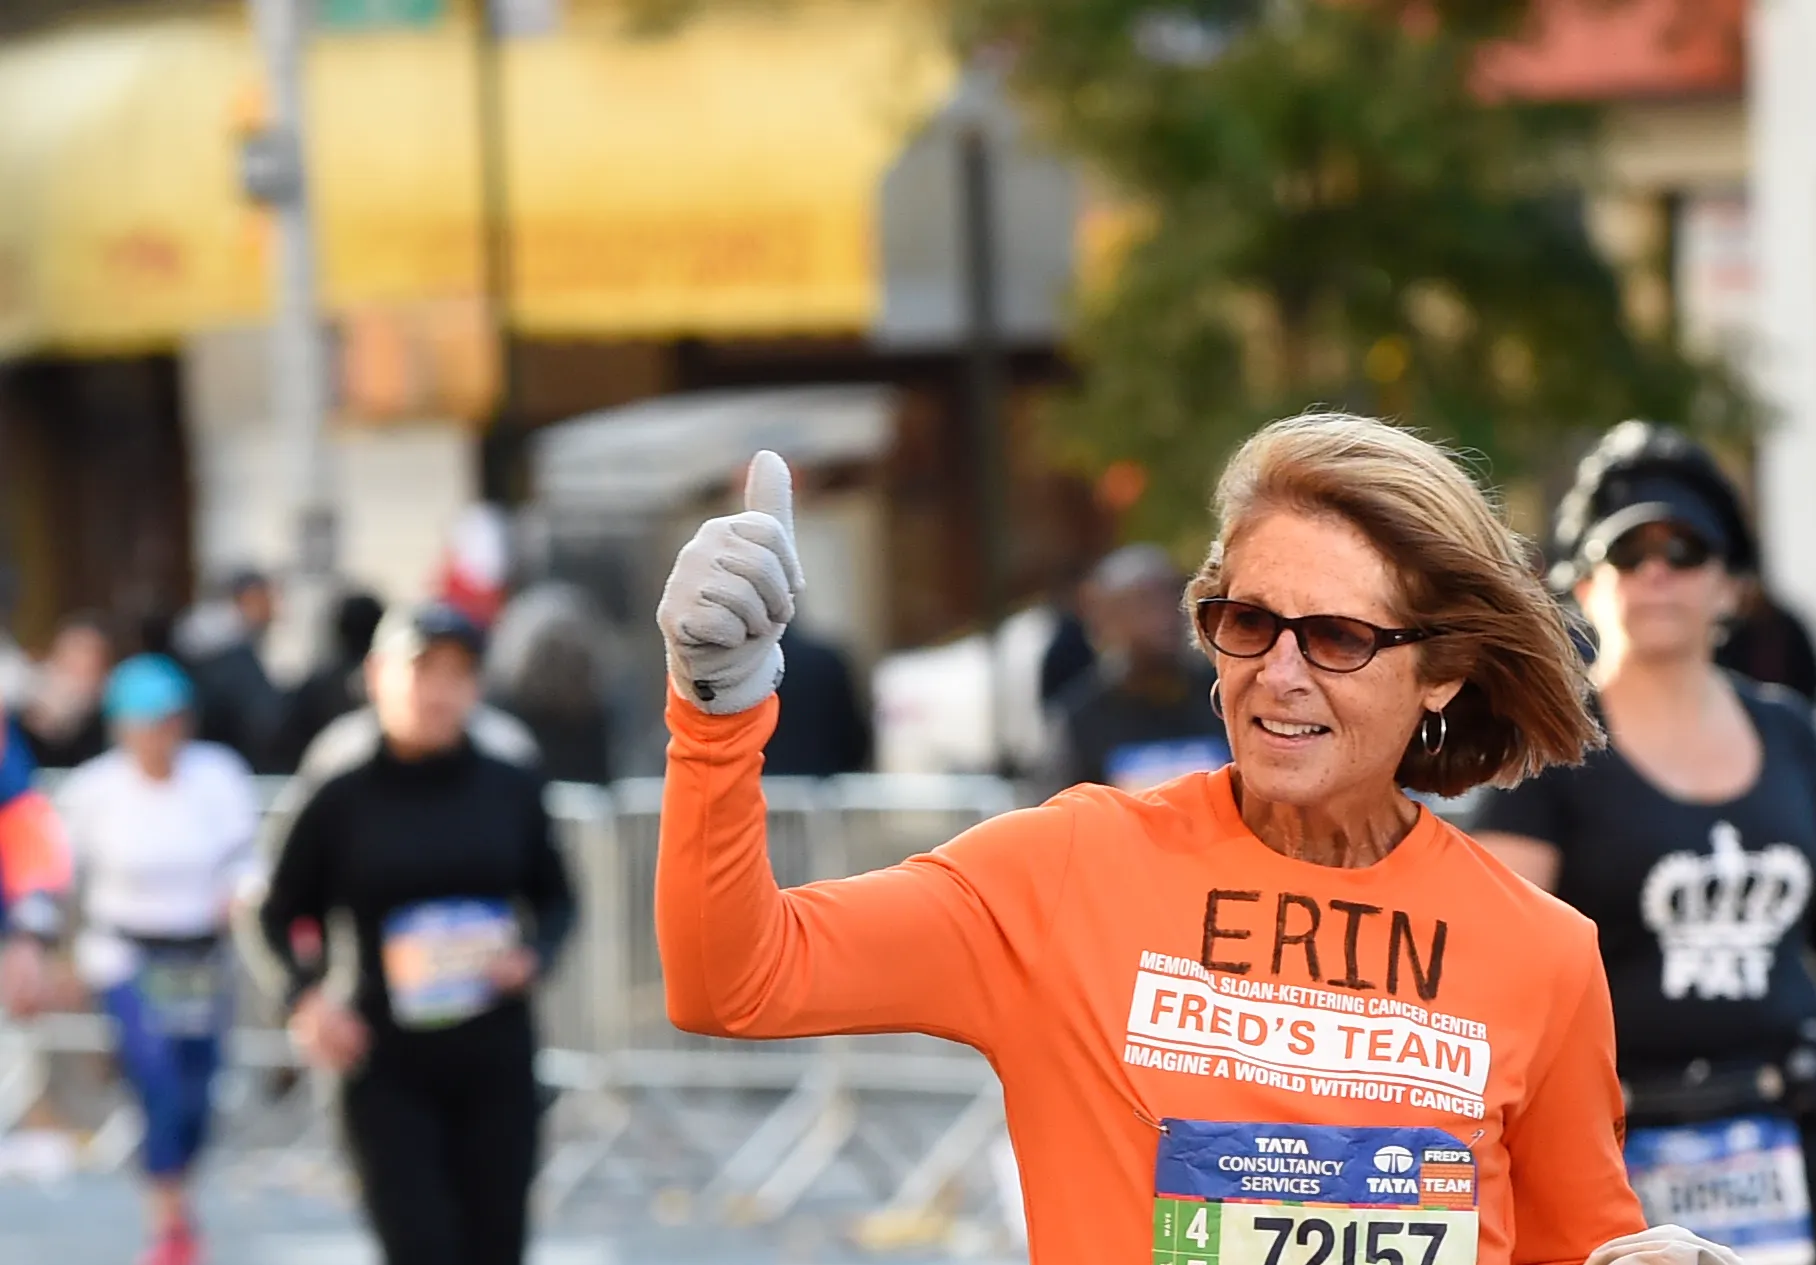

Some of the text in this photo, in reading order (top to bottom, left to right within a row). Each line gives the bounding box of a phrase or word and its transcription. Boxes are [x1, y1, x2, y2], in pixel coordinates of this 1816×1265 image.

[1200, 887, 1448, 1001] ERIN
[1140, 950, 1487, 1040] MEMORIAL SLOAN-KETTERING CANCER CENTER
[1150, 989, 1472, 1077] FRED'S TEAM
[1123, 1044, 1485, 1120] IMAGINE A WORLD WITHOUT CANCER
[1255, 1137, 1309, 1155] TATA
[1424, 1150, 1471, 1163] FRED'S
[1218, 1155, 1344, 1176] CONSULTANCY
[1241, 1176, 1320, 1195] SERVICES
[1366, 1178, 1418, 1194] TATA
[1423, 1178, 1471, 1193] TEAM
[1185, 1207, 1209, 1249] 4
